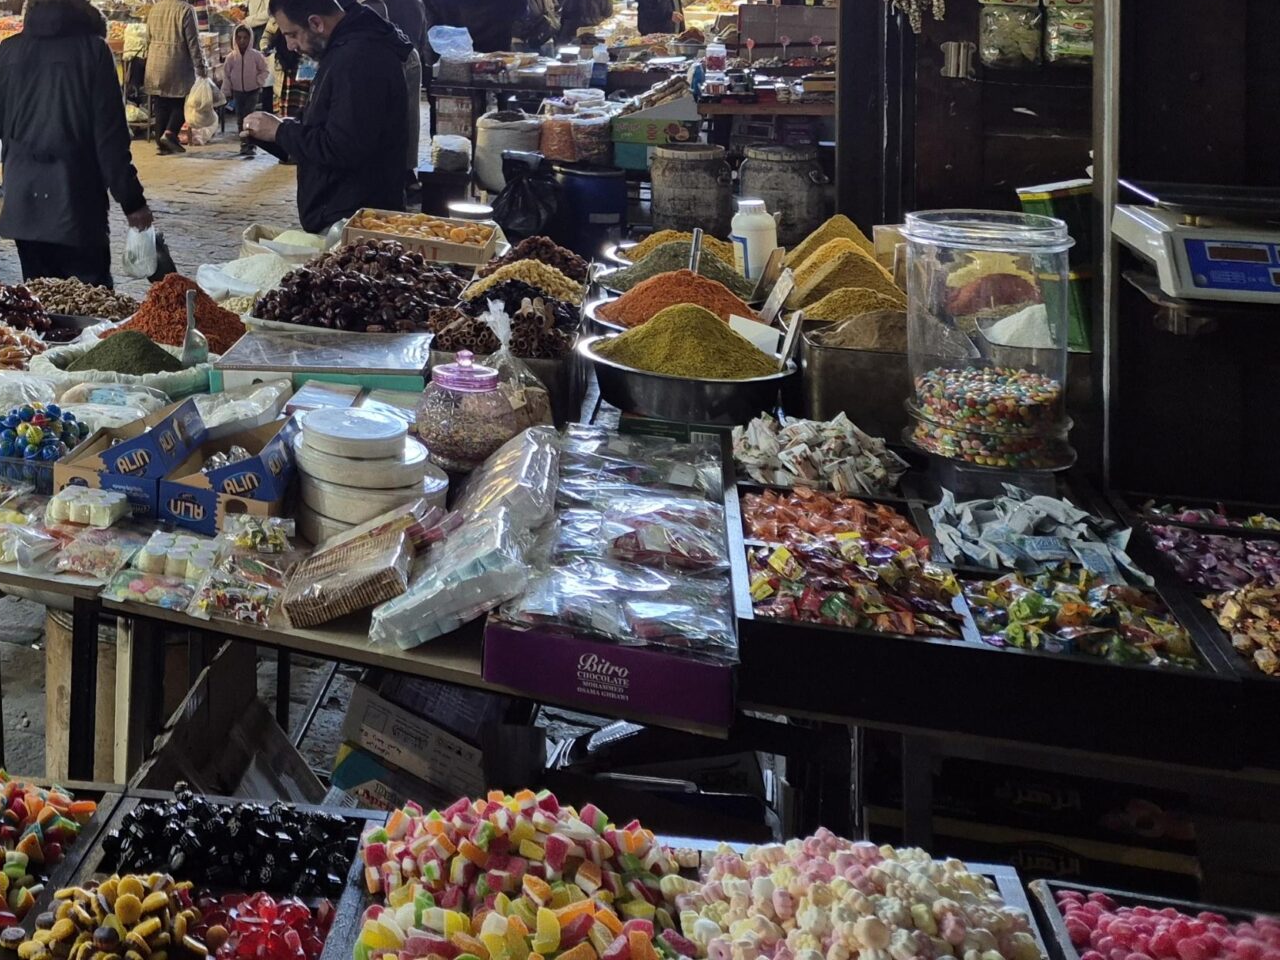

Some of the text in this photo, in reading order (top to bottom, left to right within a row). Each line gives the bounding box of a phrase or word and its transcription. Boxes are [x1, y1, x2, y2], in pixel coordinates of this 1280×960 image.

[116, 448, 150, 474] ALIN
[223, 472, 259, 495] ALIN
[170, 498, 204, 520] ALIN
[577, 653, 629, 678] Bitro
[577, 670, 630, 688] CHOCOLATE
